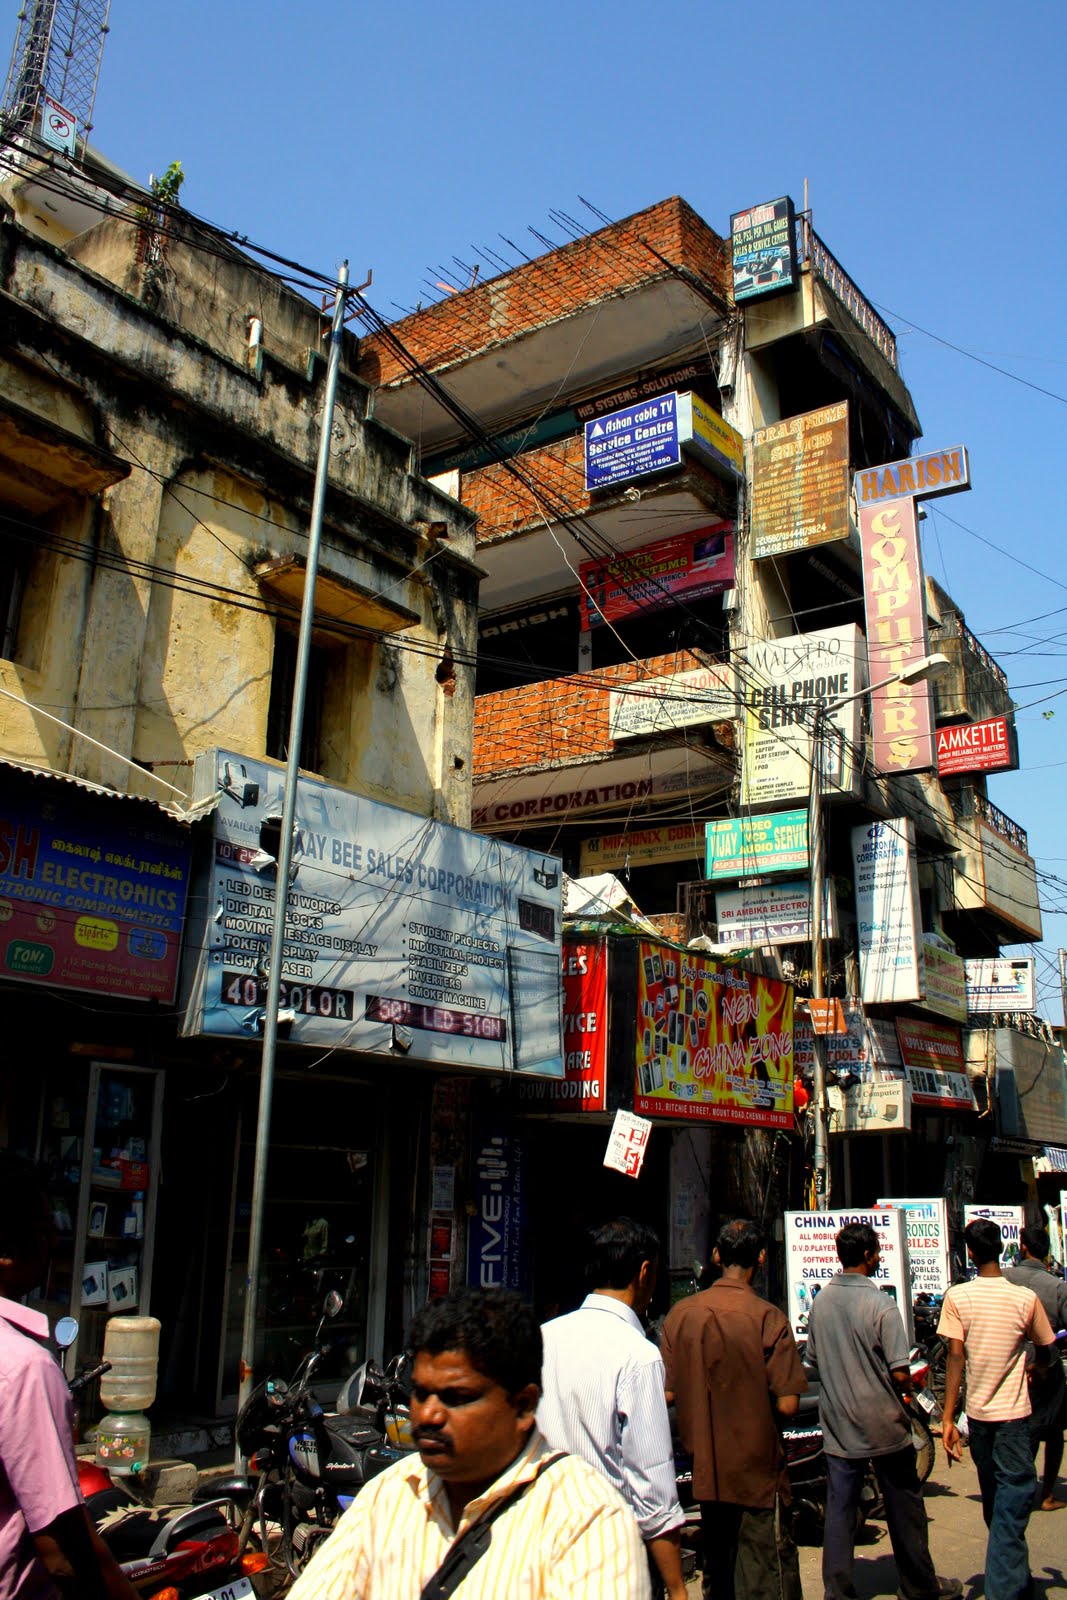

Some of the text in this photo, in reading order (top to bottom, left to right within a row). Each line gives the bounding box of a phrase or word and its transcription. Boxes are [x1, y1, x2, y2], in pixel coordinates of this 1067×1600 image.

[753, 237, 771, 252] SERVICE
[595, 388, 638, 411] SYSTEMS
[642, 366, 697, 394] SOLUTIONS
[605, 400, 673, 435] Ashan cable TV
[589, 420, 674, 456] Service Centre
[770, 430, 833, 462] SERVICES
[594, 470, 629, 485] Telephone
[860, 451, 962, 501] HARISH
[622, 556, 688, 583] SYSTEMS
[870, 509, 918, 768] COMPUTERS
[791, 673, 848, 700] PHONE
[671, 707, 699, 718] APPROVED
[938, 721, 1005, 752] AMKETTE
[755, 746, 775, 754] LAPTOP
[952, 747, 981, 757] RELIABILITY
[983, 743, 1006, 752] MATTERS
[495, 778, 653, 821] CORPORATION
[739, 820, 772, 832] VIDEO
[710, 832, 738, 858] VIJAY
[744, 832, 768, 842] VCD
[739, 842, 773, 855] AUDIO
[856, 848, 904, 863] CORPORATION
[715, 860, 735, 870] MP3
[737, 857, 768, 868] BOARD
[770, 852, 809, 863] SERVICE
[332, 838, 362, 871] BEE
[367, 848, 413, 885] SALES
[417, 865, 513, 912] CORPORATION
[42, 861, 177, 911] ELECTRONICS
[226, 879, 342, 916] LED DESN WORKS
[226, 899, 324, 930] DIGITAL LOCKS
[721, 910, 734, 919] SRI
[736, 906, 768, 917] AMBIKA
[224, 935, 268, 953] TOKEN
[225, 917, 274, 935] MOVING
[333, 937, 379, 957] DISPLAY
[408, 921, 500, 953] STUDENT PROJECTS
[881, 935, 912, 944] Connectors
[222, 952, 258, 969] LIGHT
[408, 938, 506, 971] INDUSTRIAL PROJECT
[408, 953, 469, 977] STABILIZERS
[408, 968, 462, 990] INVERTERS
[227, 977, 258, 1006] 40
[408, 984, 486, 1010] SMOKE MACHINE
[722, 994, 761, 1027] NEW
[423, 1007, 501, 1039] LED SIGN
[905, 1037, 924, 1051] APPLE
[693, 1038, 746, 1080] CHINA
[749, 1031, 794, 1065] ZONE
[519, 1079, 600, 1100] DOWNLODING
[863, 1089, 900, 1099] Computer
[640, 1101, 649, 1110] NO
[665, 1103, 688, 1113] RITCHIE
[712, 1108, 730, 1117] MOUNT
[795, 1215, 890, 1229] CHINA MOBILE
[799, 1233, 838, 1241] ALL MOBILE
[802, 1256, 834, 1264] SOFTWER
[802, 1267, 834, 1279] SALES
[922, 1274, 940, 1282] CARDS
[924, 1283, 942, 1291] RETAIL
[782, 1430, 823, 1440] Pleasure
